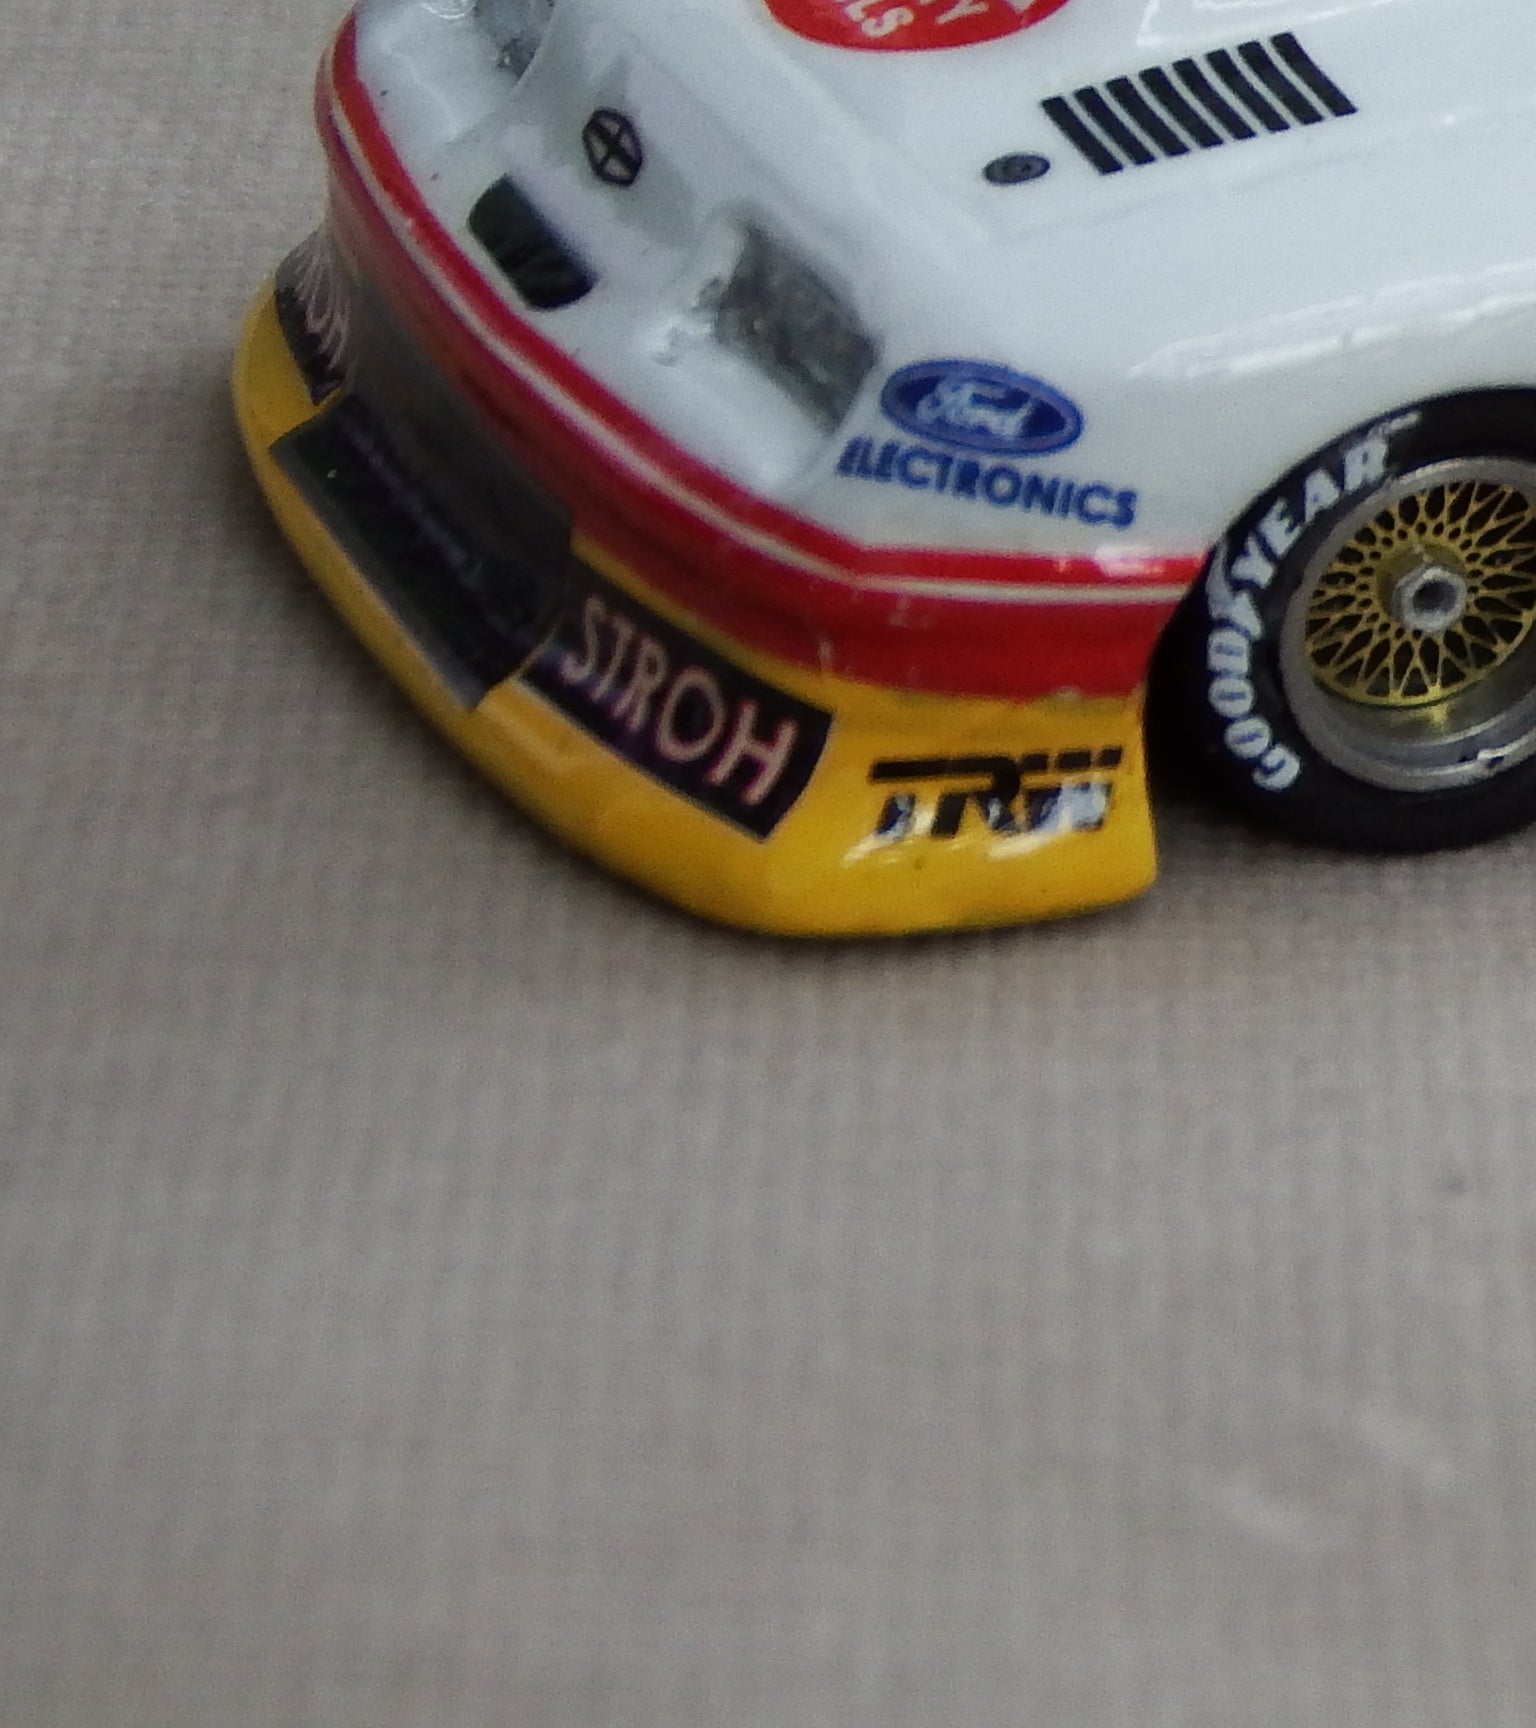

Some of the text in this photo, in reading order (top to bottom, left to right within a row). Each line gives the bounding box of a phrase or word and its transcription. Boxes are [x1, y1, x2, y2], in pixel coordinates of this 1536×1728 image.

[836, 436, 1138, 531] ELECTRONICS
[560, 593, 800, 807] STROH
[1204, 410, 1423, 792] GOODYEAR
